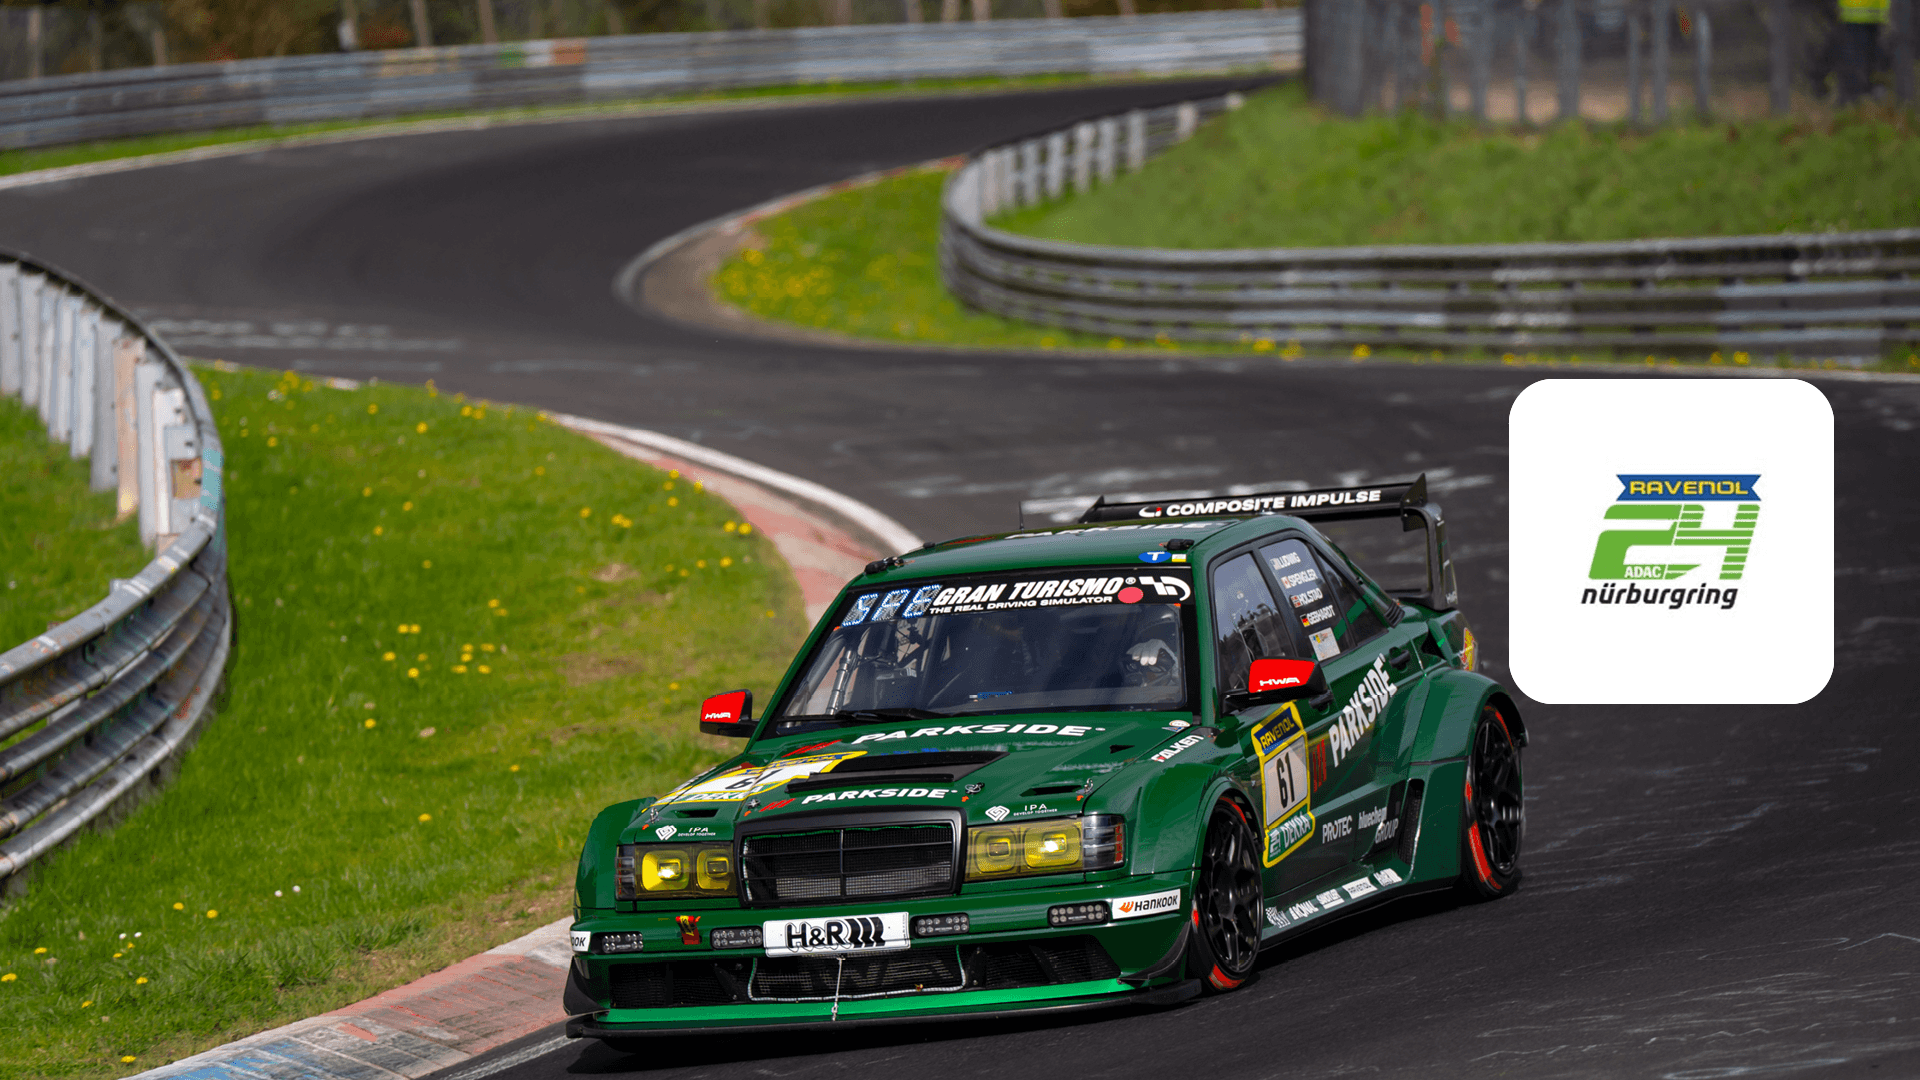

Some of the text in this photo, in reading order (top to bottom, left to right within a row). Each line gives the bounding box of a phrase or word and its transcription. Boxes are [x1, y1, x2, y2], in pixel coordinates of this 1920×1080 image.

[1166, 490, 1382, 517] COMPOSITE IMPULSE
[929, 596, 1113, 615] THE REAL DRIVING SIMULATOR
[933, 583, 1006, 606] GRAN
[1258, 676, 1300, 686] HWA
[1329, 660, 1397, 768] PARKSIDE
[851, 724, 1092, 744] PARKSIDE
[1261, 715, 1295, 749] RAVENOL
[1275, 752, 1296, 808] 61
[802, 788, 951, 804] PARKSIDE
[1025, 804, 1047, 812] IPA
[1322, 815, 1353, 844] PROTEC
[1375, 818, 1399, 844] GROUP
[786, 919, 849, 951] H&R
